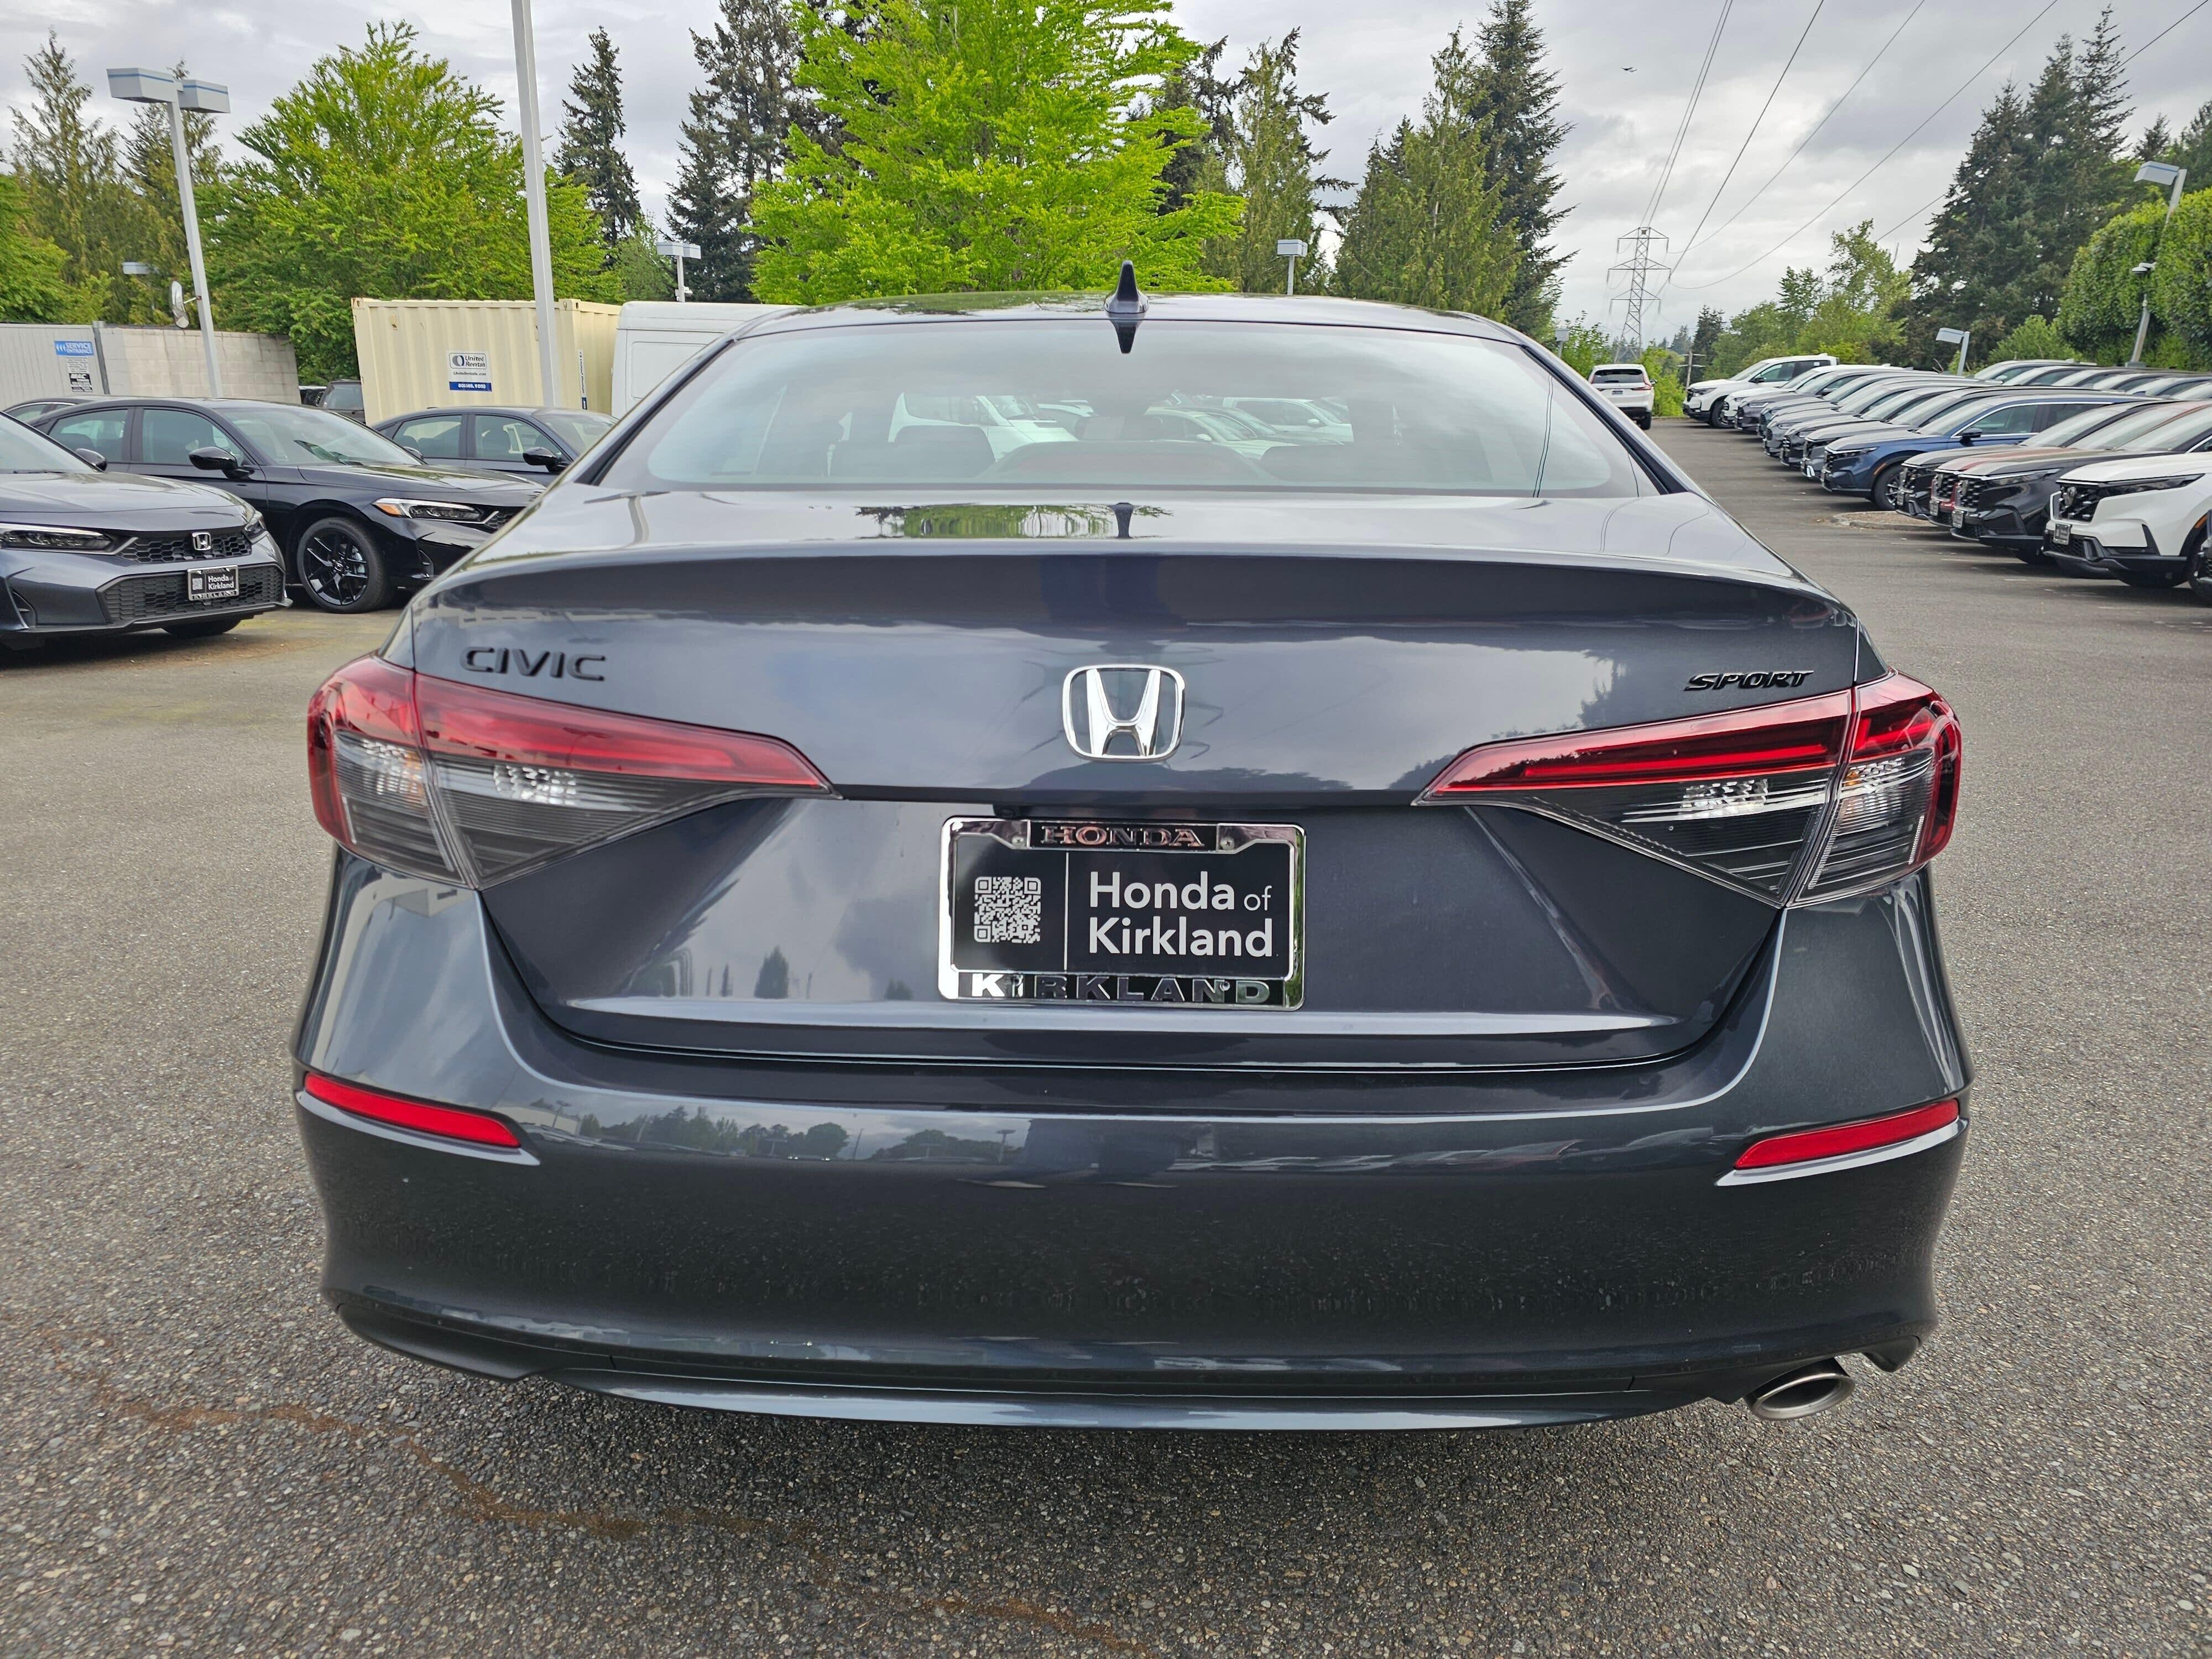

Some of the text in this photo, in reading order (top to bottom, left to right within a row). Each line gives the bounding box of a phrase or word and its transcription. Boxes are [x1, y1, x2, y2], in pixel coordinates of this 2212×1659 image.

[208, 581, 234, 590] Kirkland
[460, 646, 606, 682] CIVIC
[1684, 670, 1814, 691] SPORT
[1040, 826, 1205, 848] HONDA
[1090, 871, 1272, 911] Honda of
[1089, 916, 1272, 957] Kirkland
[971, 973, 1271, 1004] KIRKLAND
